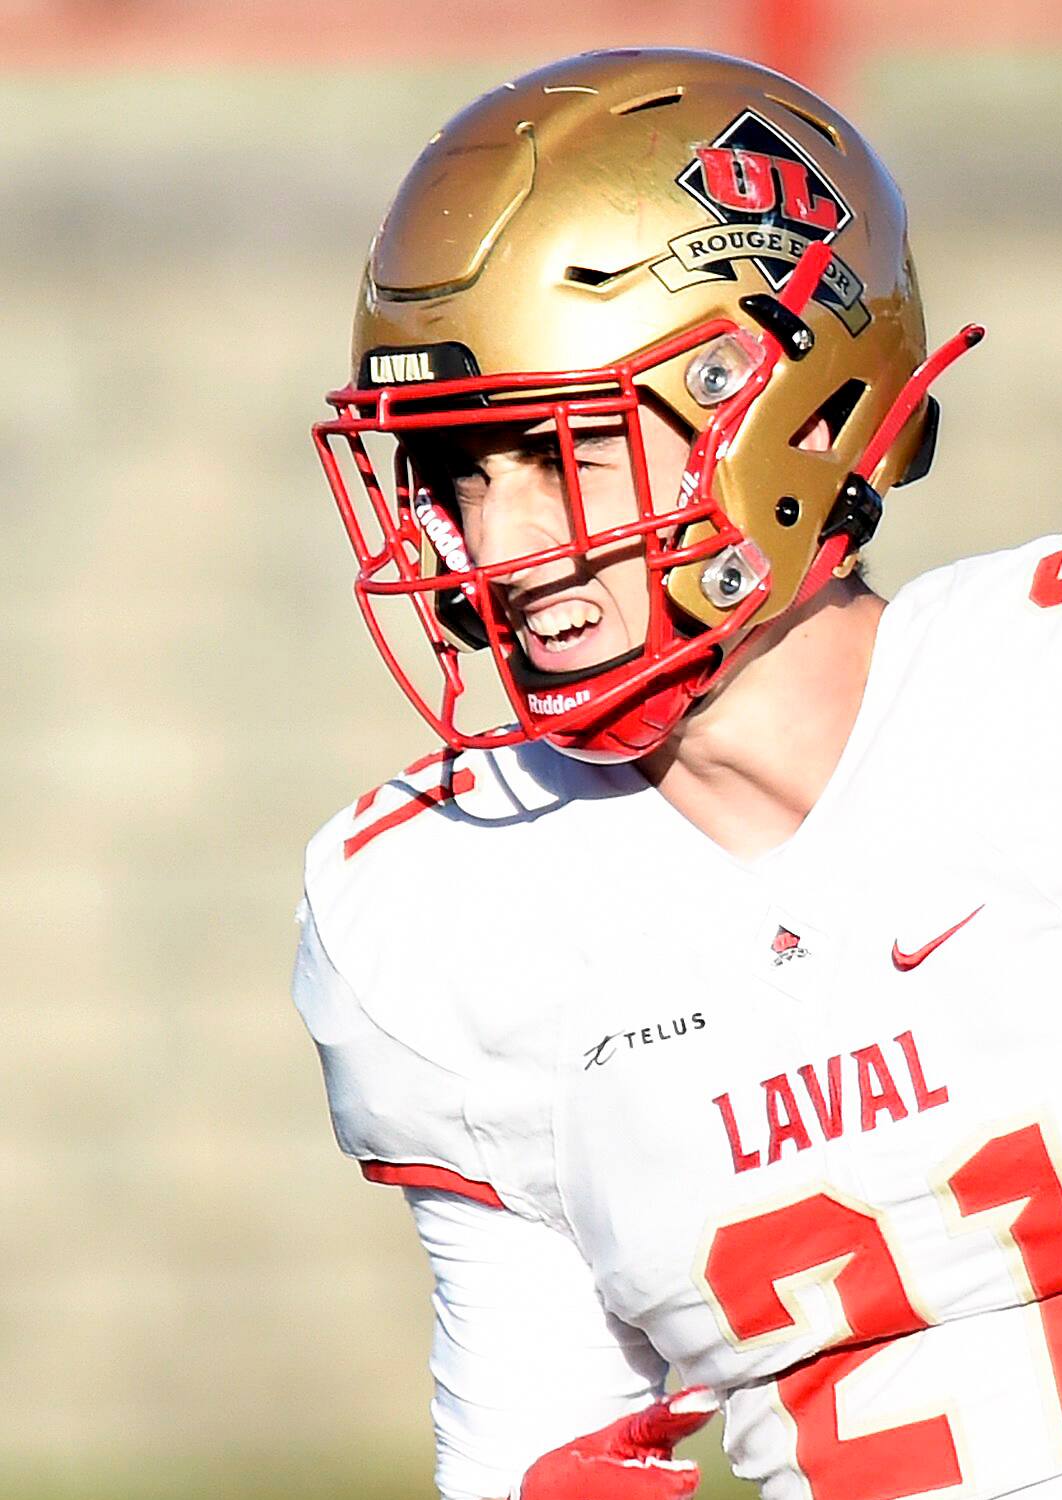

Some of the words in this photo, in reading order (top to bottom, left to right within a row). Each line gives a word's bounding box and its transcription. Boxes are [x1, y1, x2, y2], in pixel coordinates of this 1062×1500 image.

[696, 147, 839, 231] UL
[687, 231, 783, 259] ROUGE
[369, 352, 435, 383] LAVAL
[623, 1012, 706, 1049] TELUS
[711, 1029, 950, 1175] LAVAL
